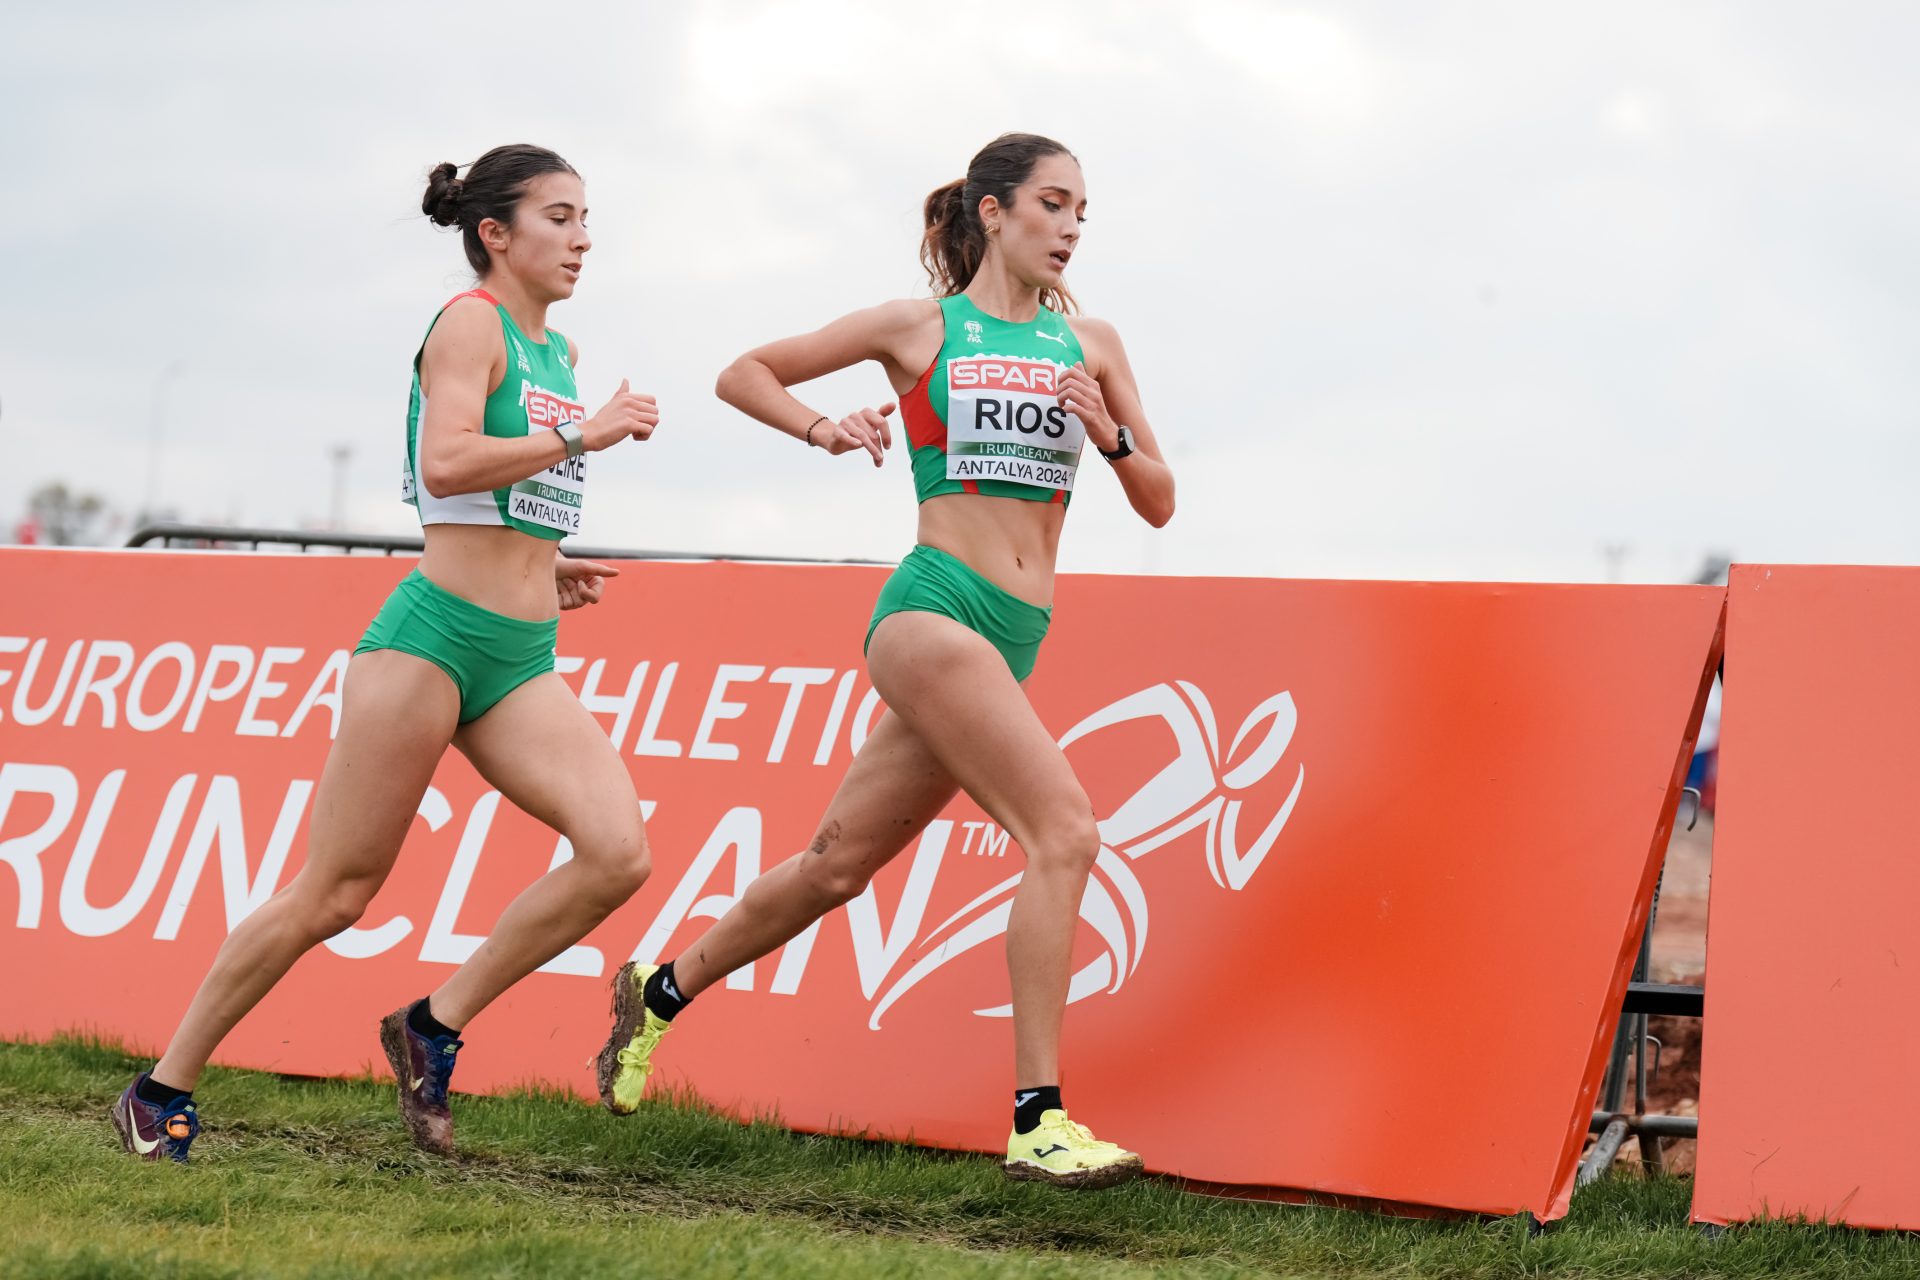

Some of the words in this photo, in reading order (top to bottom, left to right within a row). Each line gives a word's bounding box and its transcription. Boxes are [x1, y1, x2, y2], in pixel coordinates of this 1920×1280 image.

[953, 363, 1054, 391] SPAR
[975, 398, 1067, 438] RIOS
[979, 443, 984, 454] I
[956, 460, 1033, 480] ANTALYA
[1035, 466, 1069, 486] 2024
[514, 498, 571, 526] ANTALYA
[0, 635, 350, 740] UROPEA
[0, 762, 314, 941] RUN
